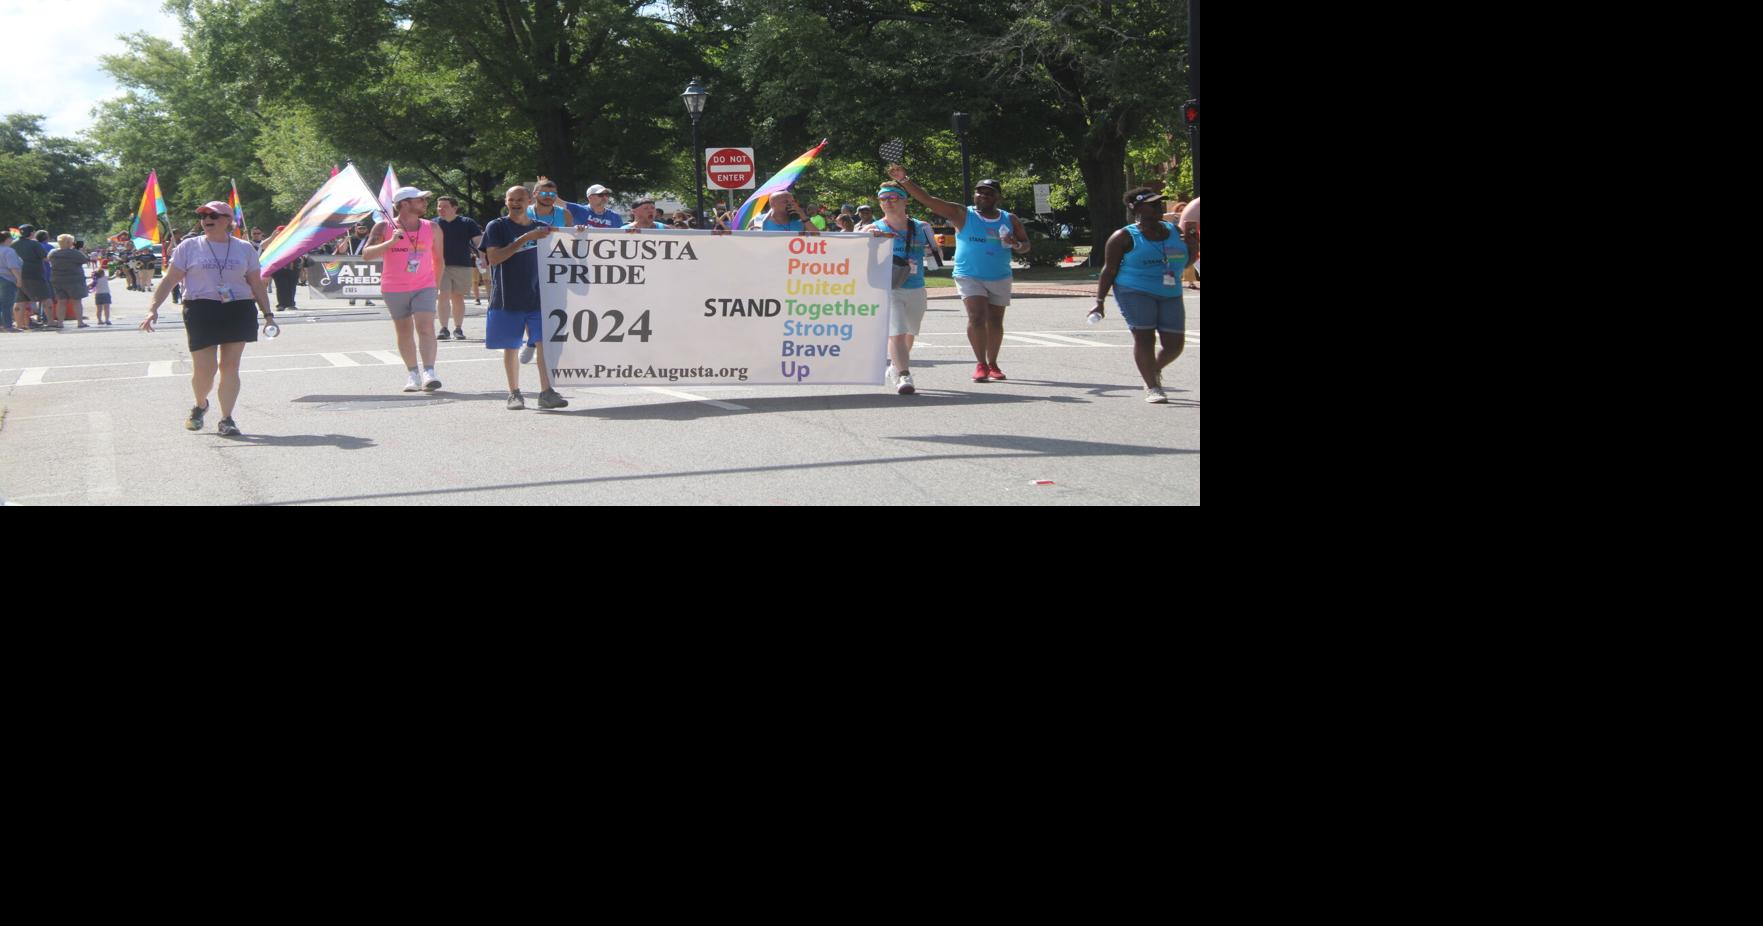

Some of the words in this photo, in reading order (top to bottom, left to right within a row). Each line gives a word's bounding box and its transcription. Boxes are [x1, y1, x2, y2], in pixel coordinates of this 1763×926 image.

[730, 155, 748, 163] NOT
[717, 174, 745, 182] ENTER
[587, 214, 612, 226] LOVE
[547, 239, 698, 260] AUGUSTA
[788, 237, 828, 255] Out
[337, 264, 382, 277] ATL
[546, 263, 646, 284] PRIDE
[787, 258, 850, 276] Proud
[337, 276, 381, 285] FREED
[786, 278, 856, 296] United
[704, 297, 781, 317] STAND
[785, 299, 880, 320] Together
[548, 308, 653, 343] 2024
[783, 319, 853, 341] Strong
[782, 340, 841, 357] Brave
[551, 364, 748, 381] www.PrideAugusta.org
[781, 360, 810, 381] Up
